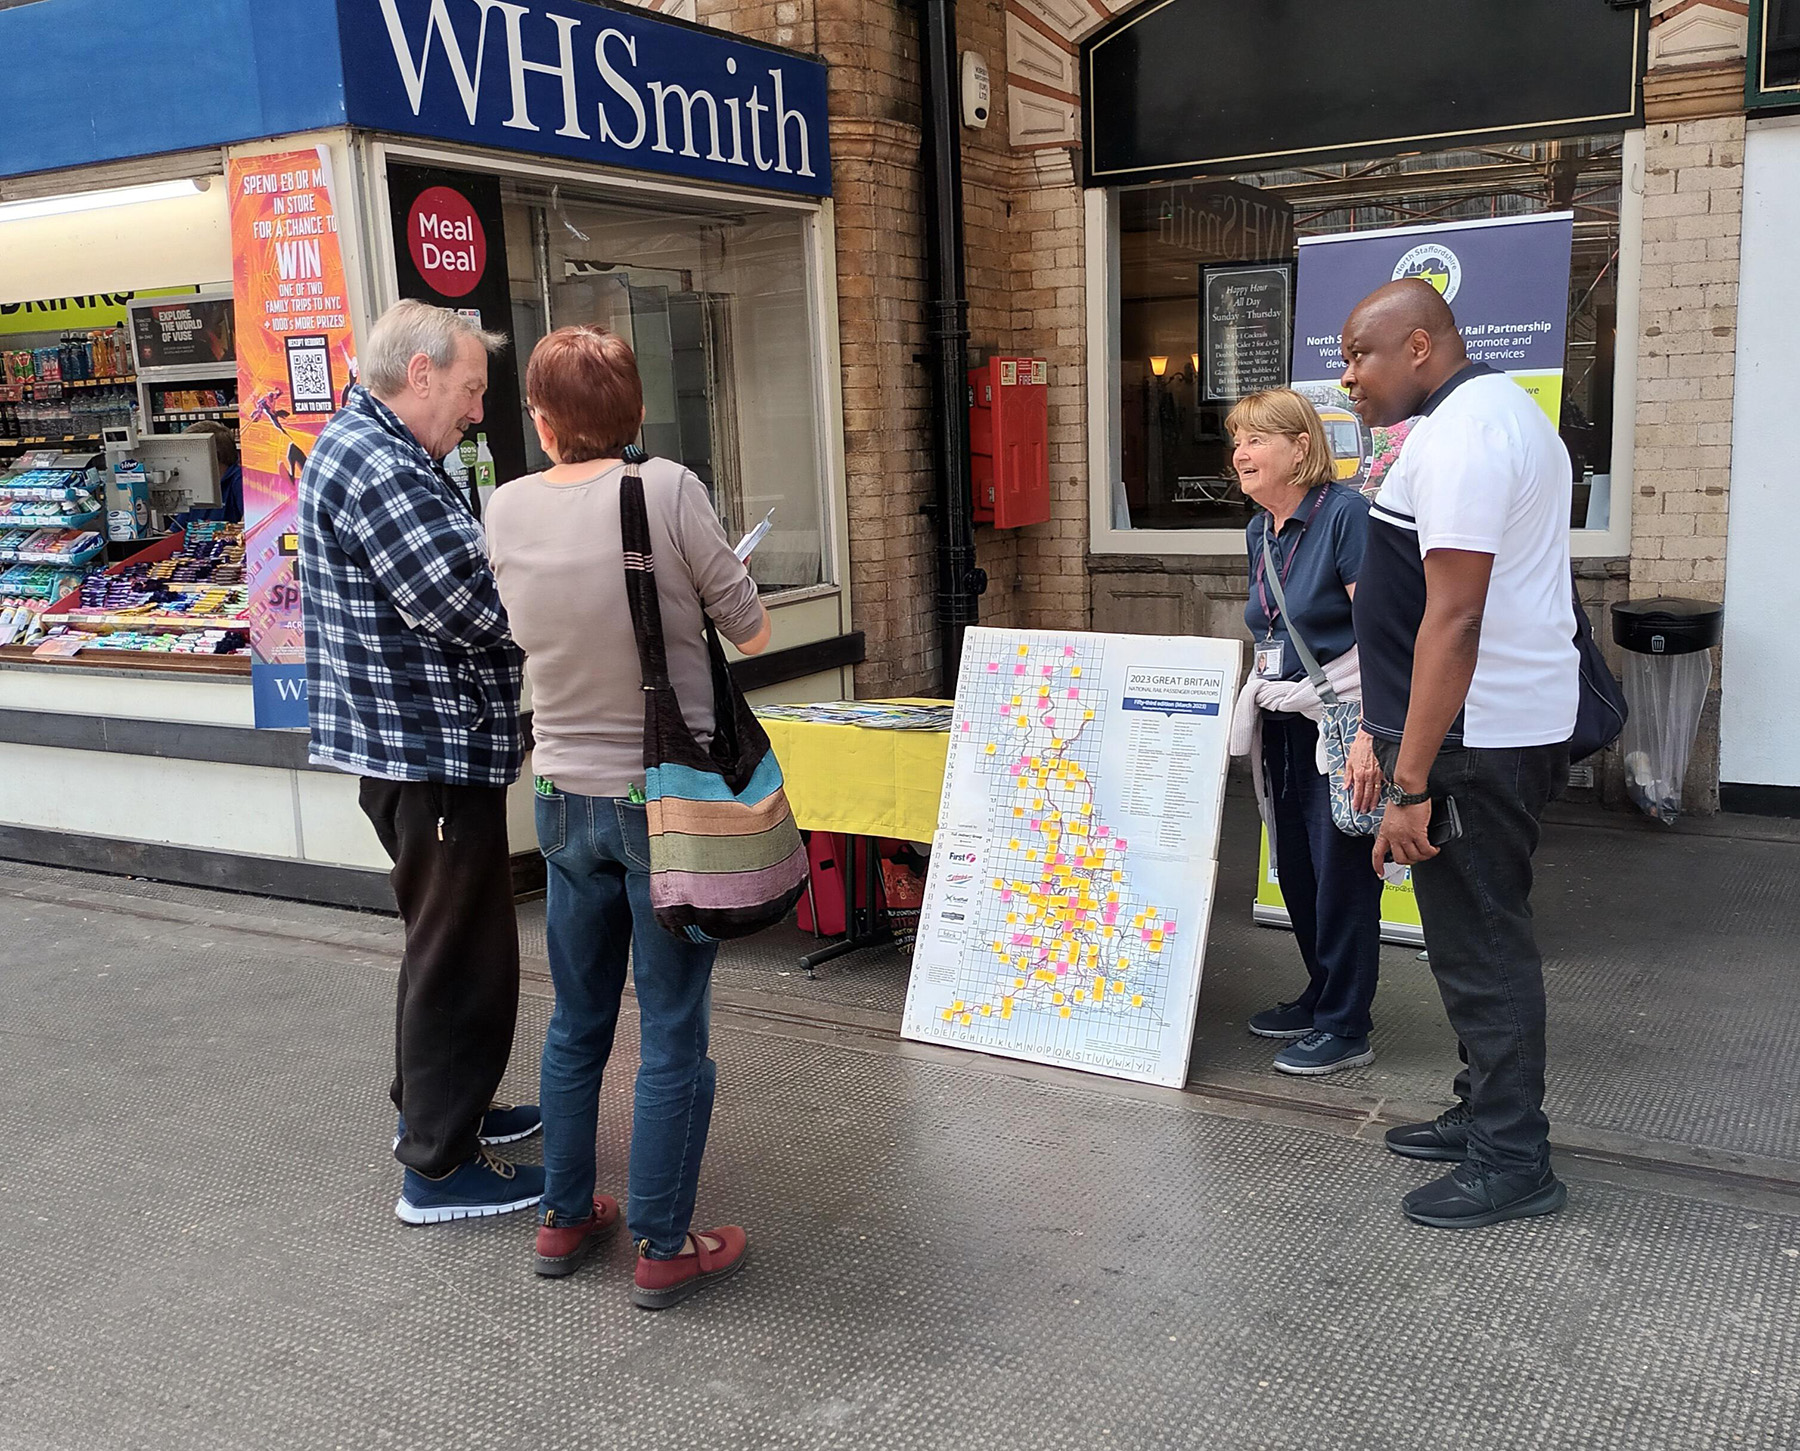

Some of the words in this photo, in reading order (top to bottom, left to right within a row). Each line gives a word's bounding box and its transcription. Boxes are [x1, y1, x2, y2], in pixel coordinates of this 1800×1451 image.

[379, 0, 816, 178] WHSmith
[244, 174, 278, 195] SPEND
[280, 172, 294, 192] £8
[296, 170, 310, 190] OR
[274, 197, 284, 215] IN
[288, 194, 316, 214] STORE
[253, 221, 272, 239] FOR
[276, 220, 284, 238] A
[286, 216, 324, 237] CHANCE
[326, 215, 338, 233] TO
[419, 213, 474, 242] Meal
[275, 238, 322, 280] WIN
[422, 242, 477, 272] Deal
[1395, 253, 1415, 275] North
[1414, 245, 1457, 271] Staffordshire
[279, 283, 294, 297] ONE
[296, 282, 304, 296] OF
[307, 281, 323, 295] TWO
[1226, 284, 1249, 296] Happy
[1250, 283, 1268, 293] Hour
[265, 300, 289, 313] FAMILY
[290, 298, 312, 312] TRIPS
[313, 298, 323, 311] TO
[324, 296, 342, 310] NYC
[1233, 298, 1244, 307] All
[1246, 298, 1261, 308] Day
[158, 309, 192, 322] EXPLORE
[295, 316, 315, 330] MORE
[316, 314, 346, 329] PRIZES!
[1212, 311, 1240, 322] Sunday
[1246, 309, 1282, 320] Thursday
[160, 321, 175, 332] THE
[176, 320, 202, 330] WORLD
[1465, 324, 1485, 336] Rail
[1487, 321, 1552, 337] Partnership
[162, 332, 172, 342] OF
[172, 331, 192, 341] VUSE
[1244, 332, 1268, 340] Cocktails
[1306, 335, 1334, 346] North
[1466, 338, 1510, 350] promote
[1512, 335, 1532, 345] and
[1319, 347, 1342, 356] Work
[1484, 349, 1525, 360] services
[1326, 360, 1348, 368] deve
[1019, 376, 1032, 386] FIRE
[296, 402, 308, 412] SCAN
[316, 402, 332, 411] ENTER
[1130, 675, 1151, 684] 2023
[1152, 676, 1182, 686] GREAT
[1184, 678, 1220, 688] BRITAIN
[949, 852, 966, 861] First
[1386, 884, 1414, 894] scrp@st
